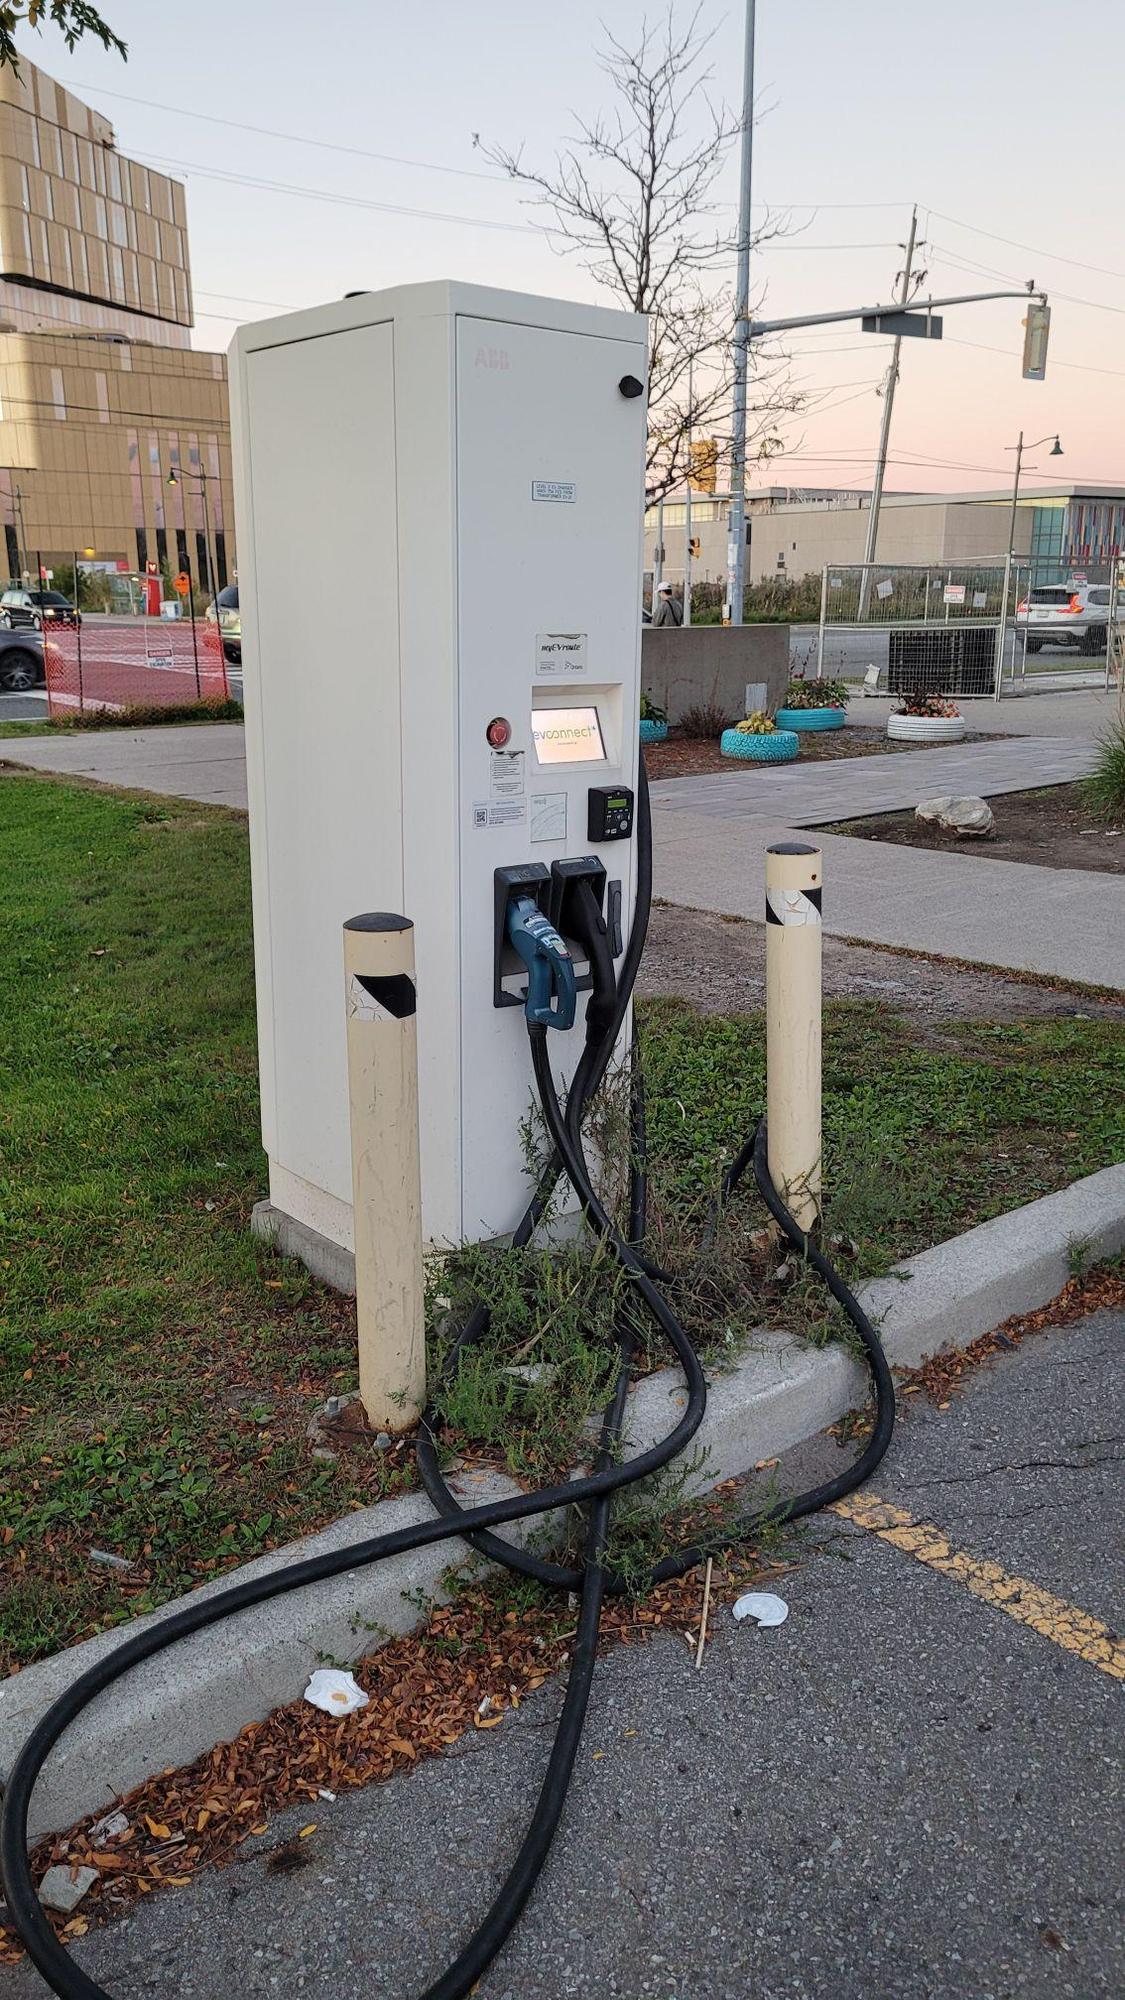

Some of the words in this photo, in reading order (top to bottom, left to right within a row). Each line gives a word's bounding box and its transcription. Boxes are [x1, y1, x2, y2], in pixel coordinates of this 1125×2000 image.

[474, 347, 511, 369] ABB
[541, 644, 581, 652] myEVroute
[533, 726, 592, 740] evconnect
